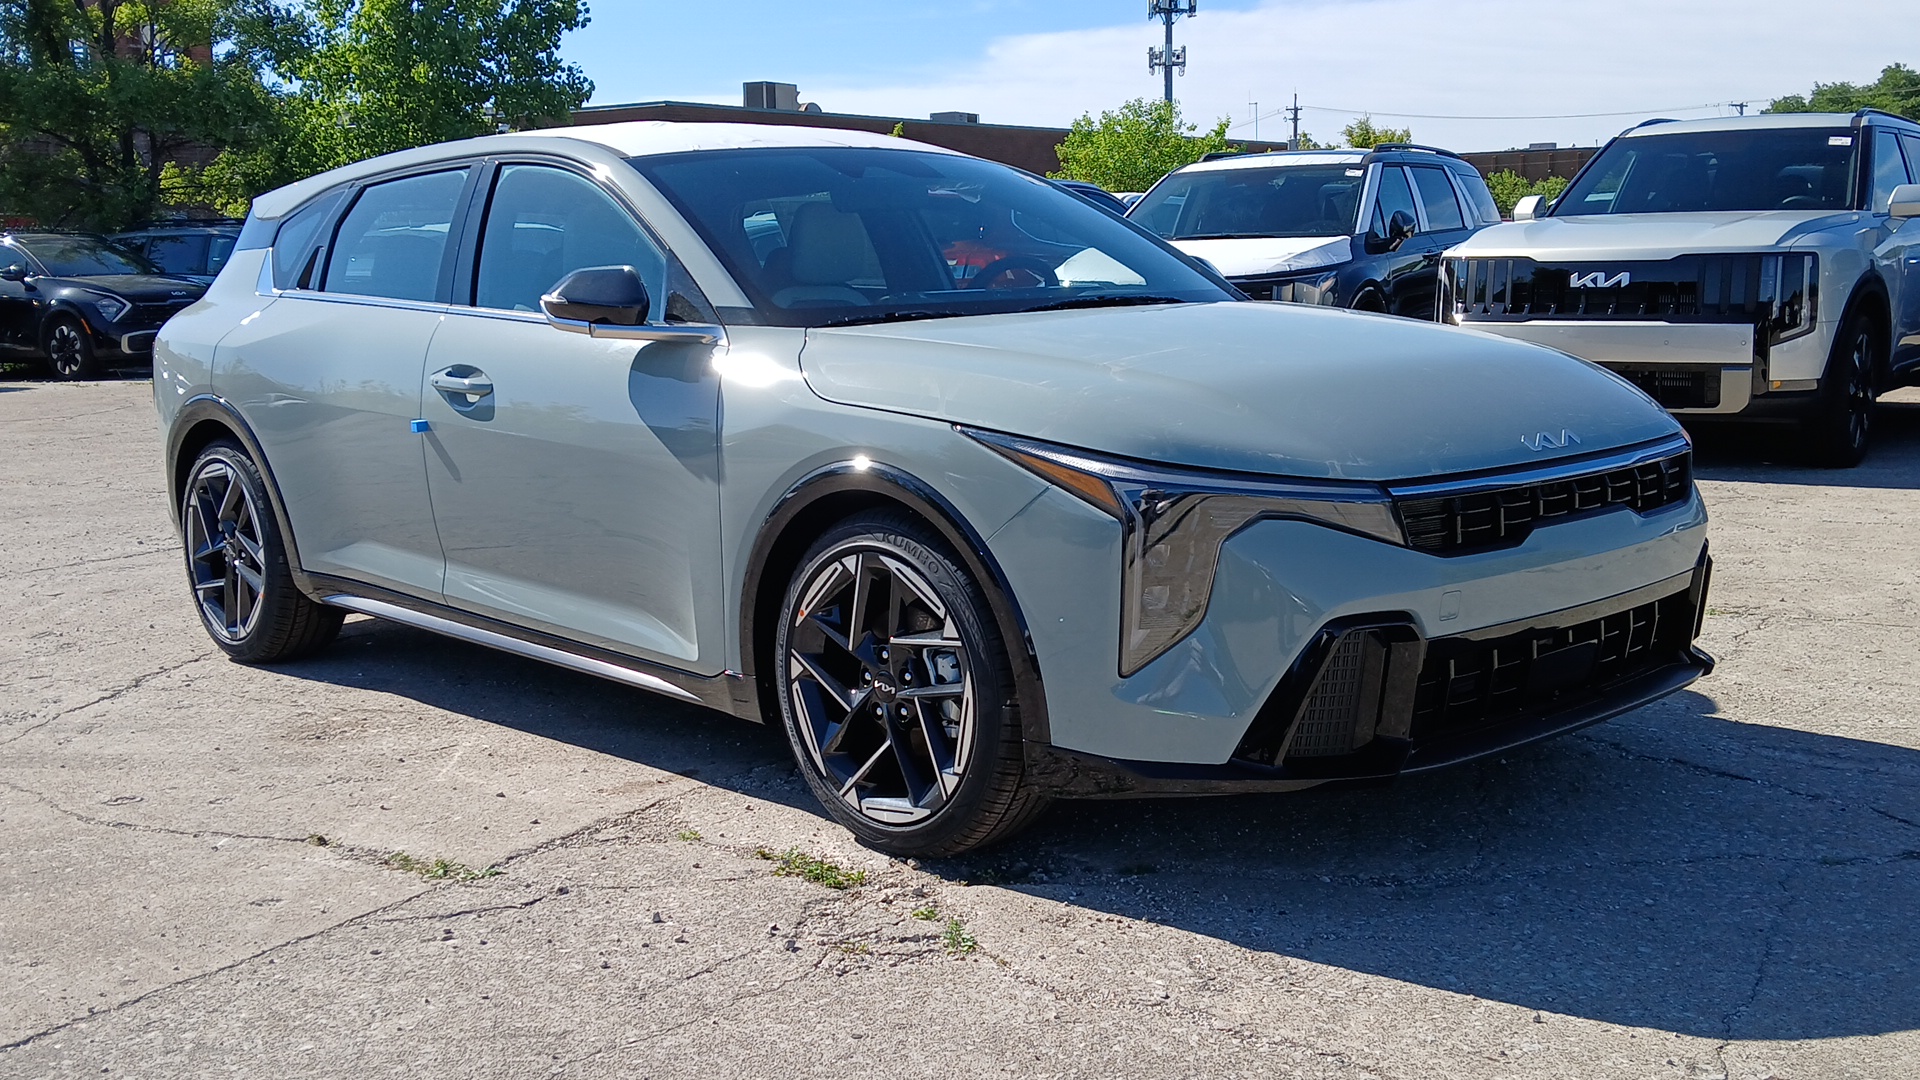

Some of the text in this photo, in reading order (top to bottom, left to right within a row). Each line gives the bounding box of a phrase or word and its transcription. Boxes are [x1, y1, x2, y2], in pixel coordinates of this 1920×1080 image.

[1569, 271, 1630, 288] KIA
[1520, 429, 1581, 452] KIA
[881, 533, 939, 574] KUMHO
[874, 679, 896, 695] KIA
